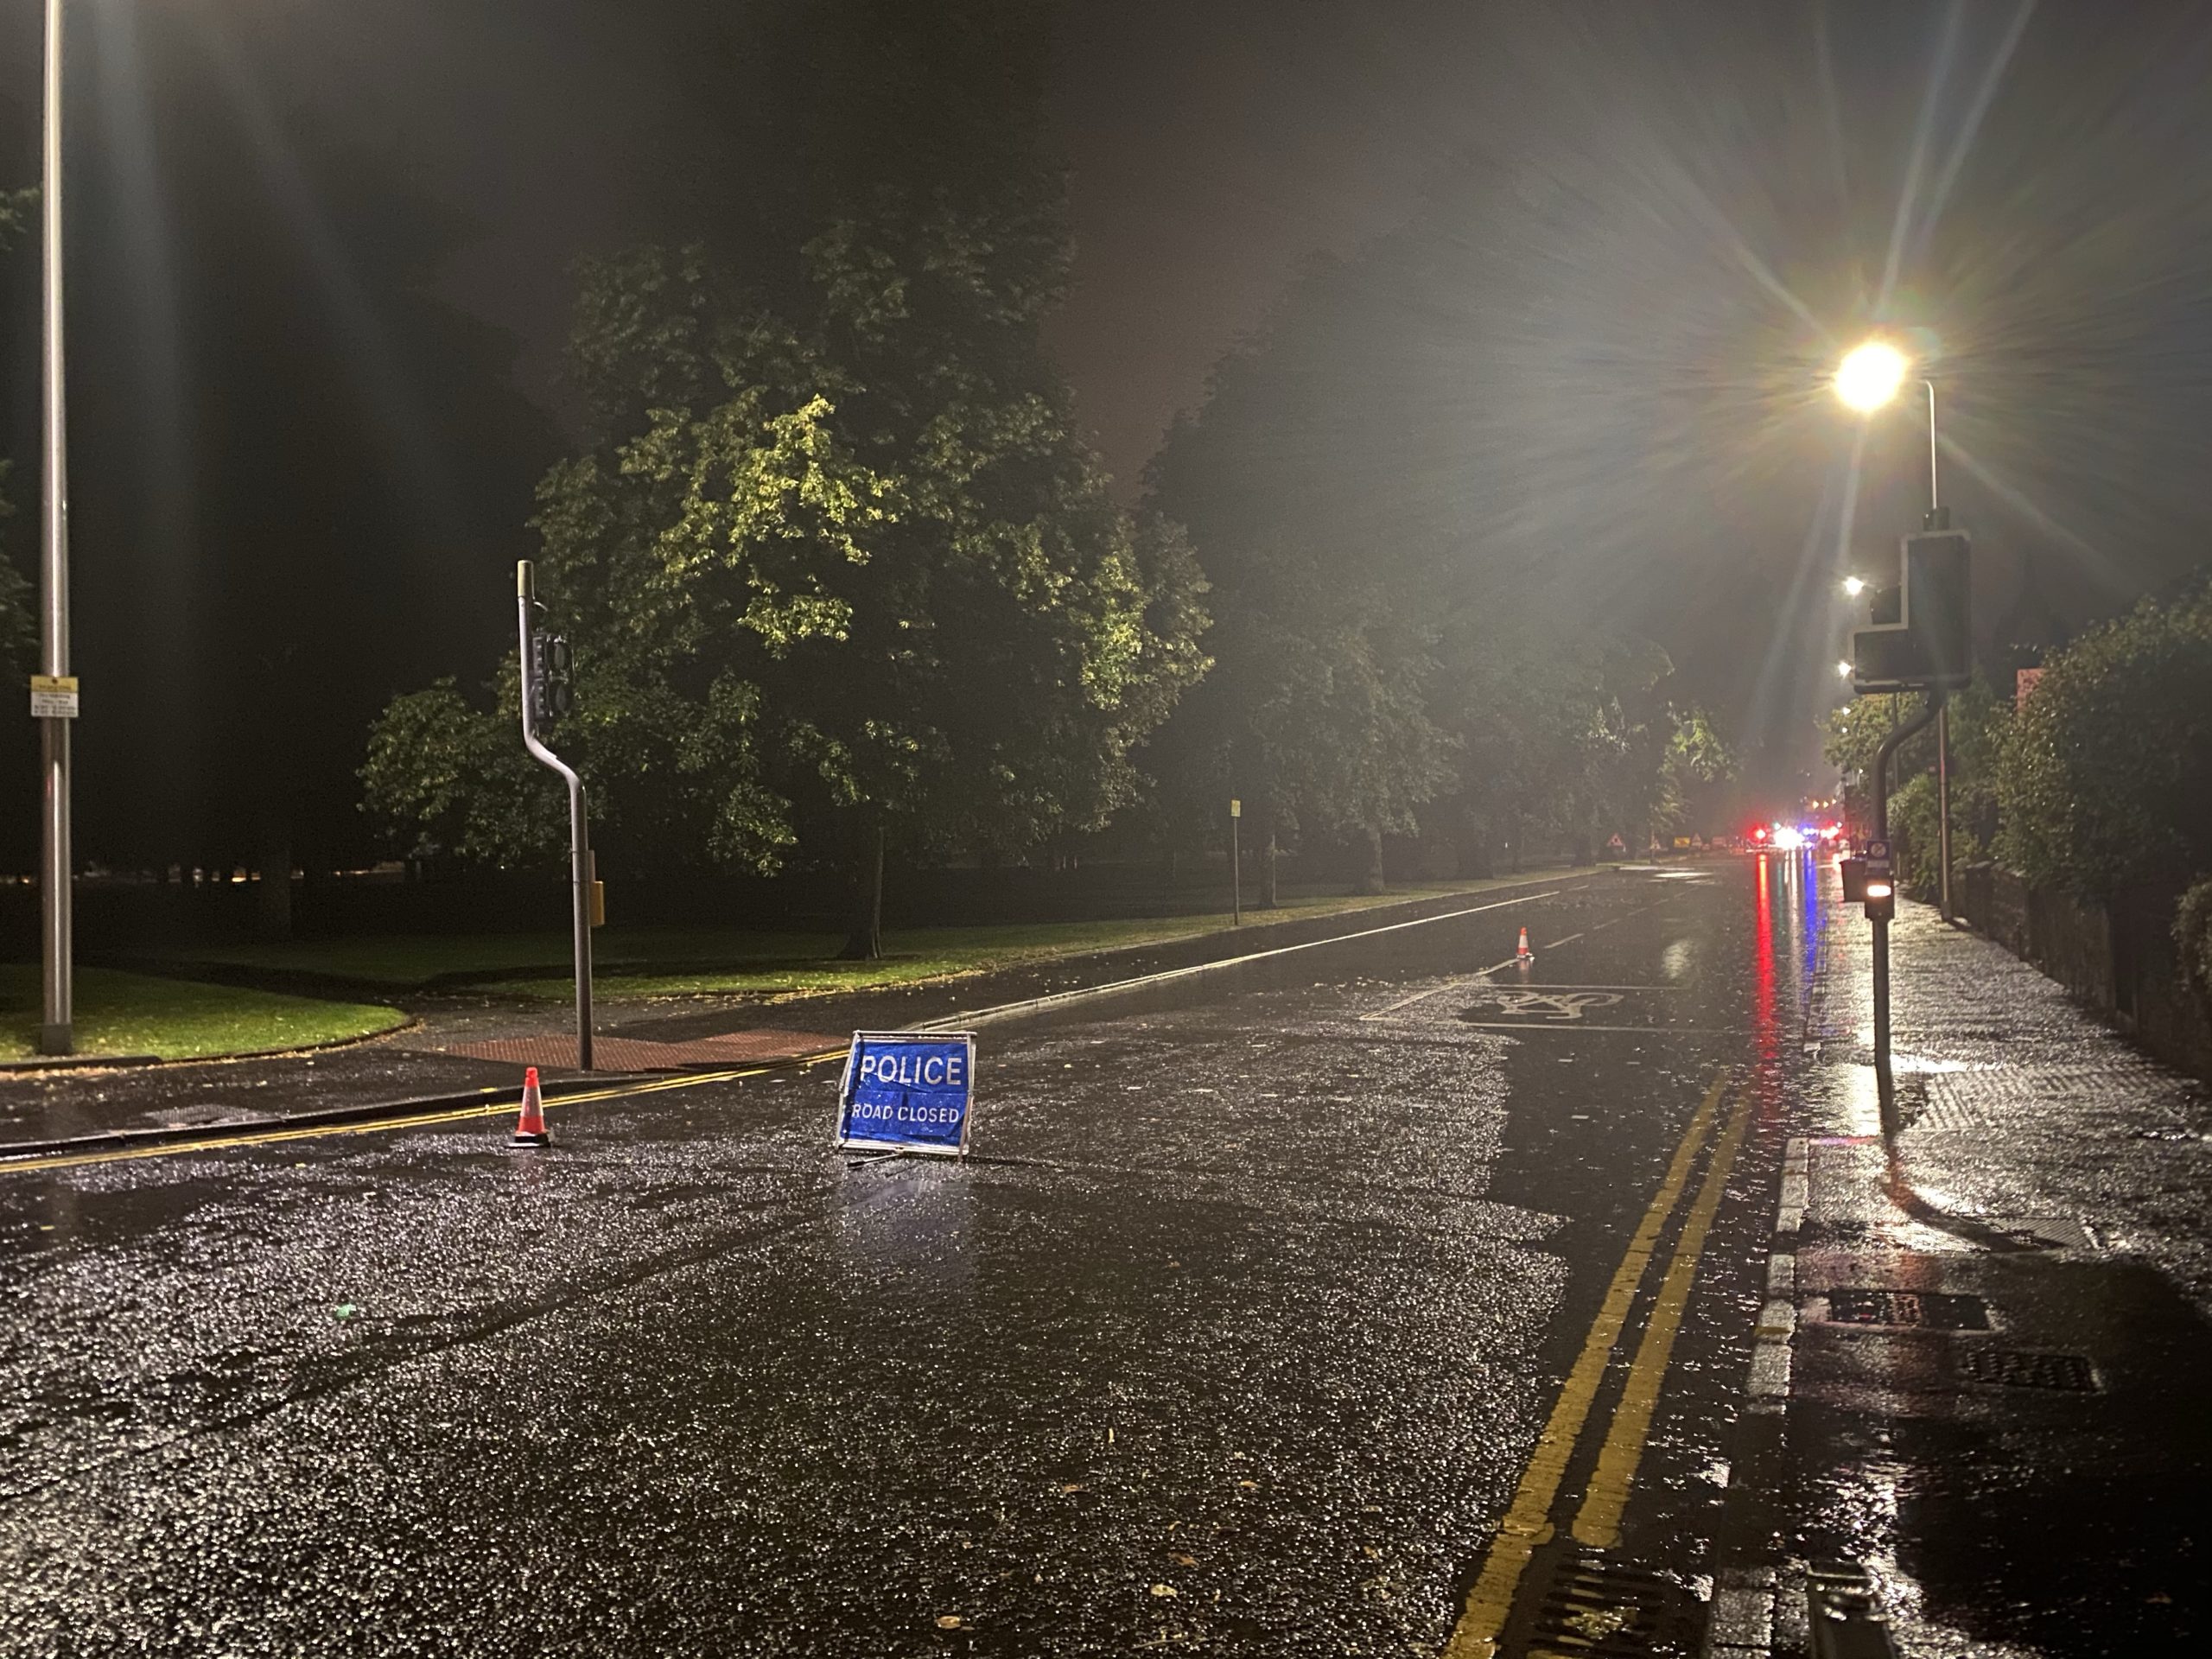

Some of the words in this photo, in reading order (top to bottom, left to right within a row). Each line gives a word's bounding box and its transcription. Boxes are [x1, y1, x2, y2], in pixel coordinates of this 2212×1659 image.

[860, 1056, 962, 1084] POLICE
[852, 1104, 893, 1119] ROAD
[899, 1107, 958, 1122] CLOSED
